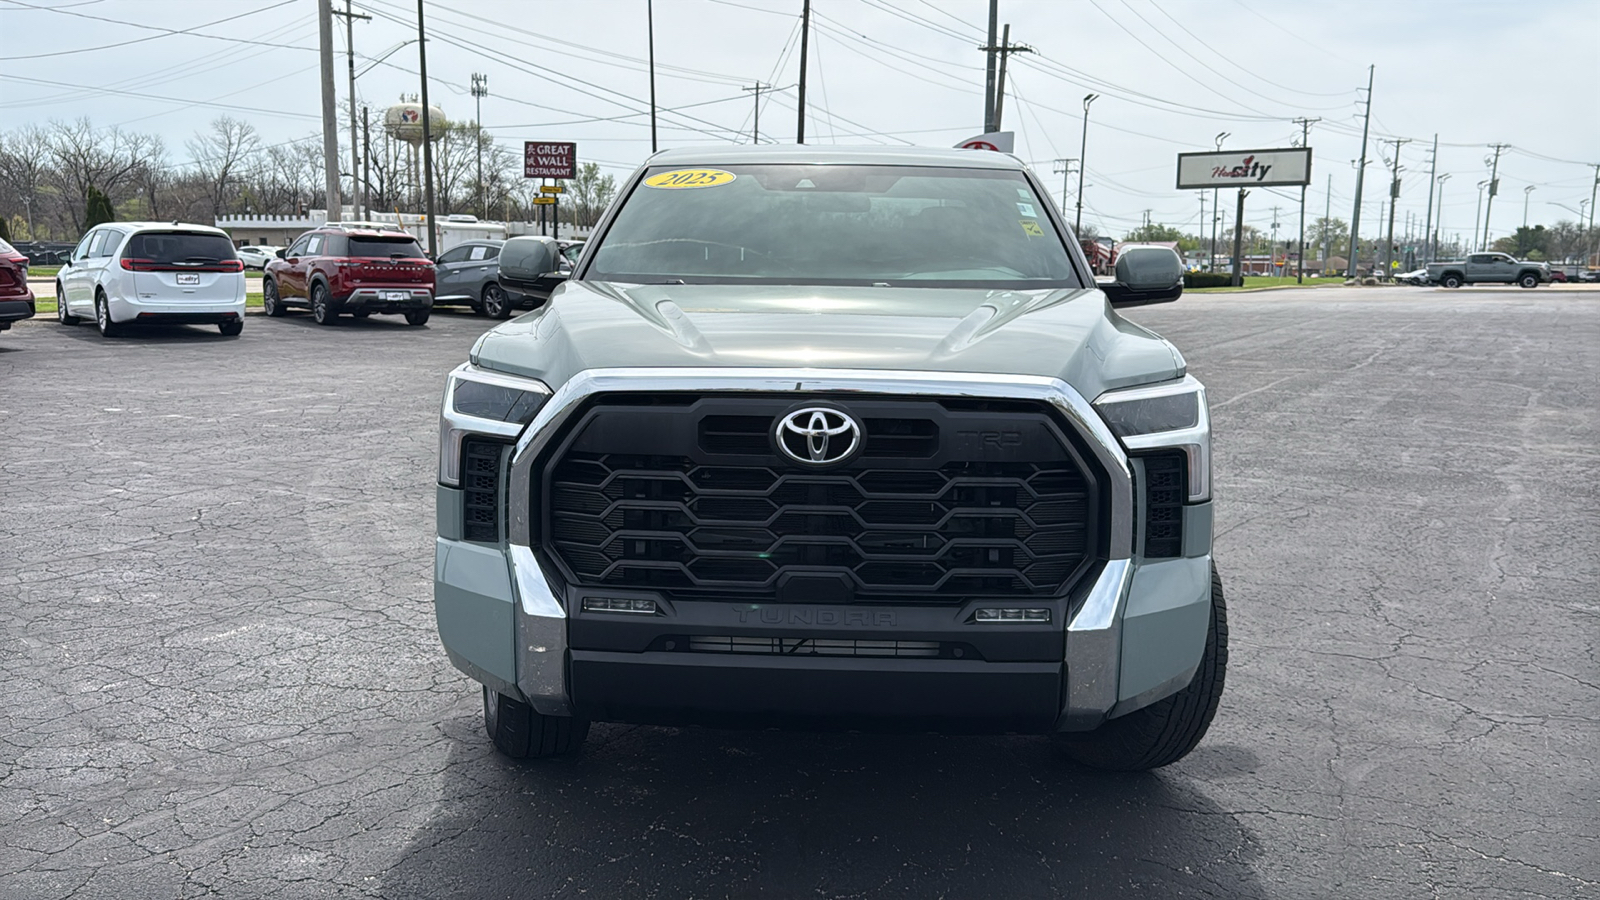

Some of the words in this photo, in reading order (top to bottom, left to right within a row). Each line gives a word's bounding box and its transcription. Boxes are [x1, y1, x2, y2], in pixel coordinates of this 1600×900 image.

[537, 144, 570, 155] GREAT
[537, 156, 569, 166] WALL
[656, 172, 724, 186] 2025
[957, 430, 1022, 449] TRD
[732, 606, 898, 627] TUNDRA
